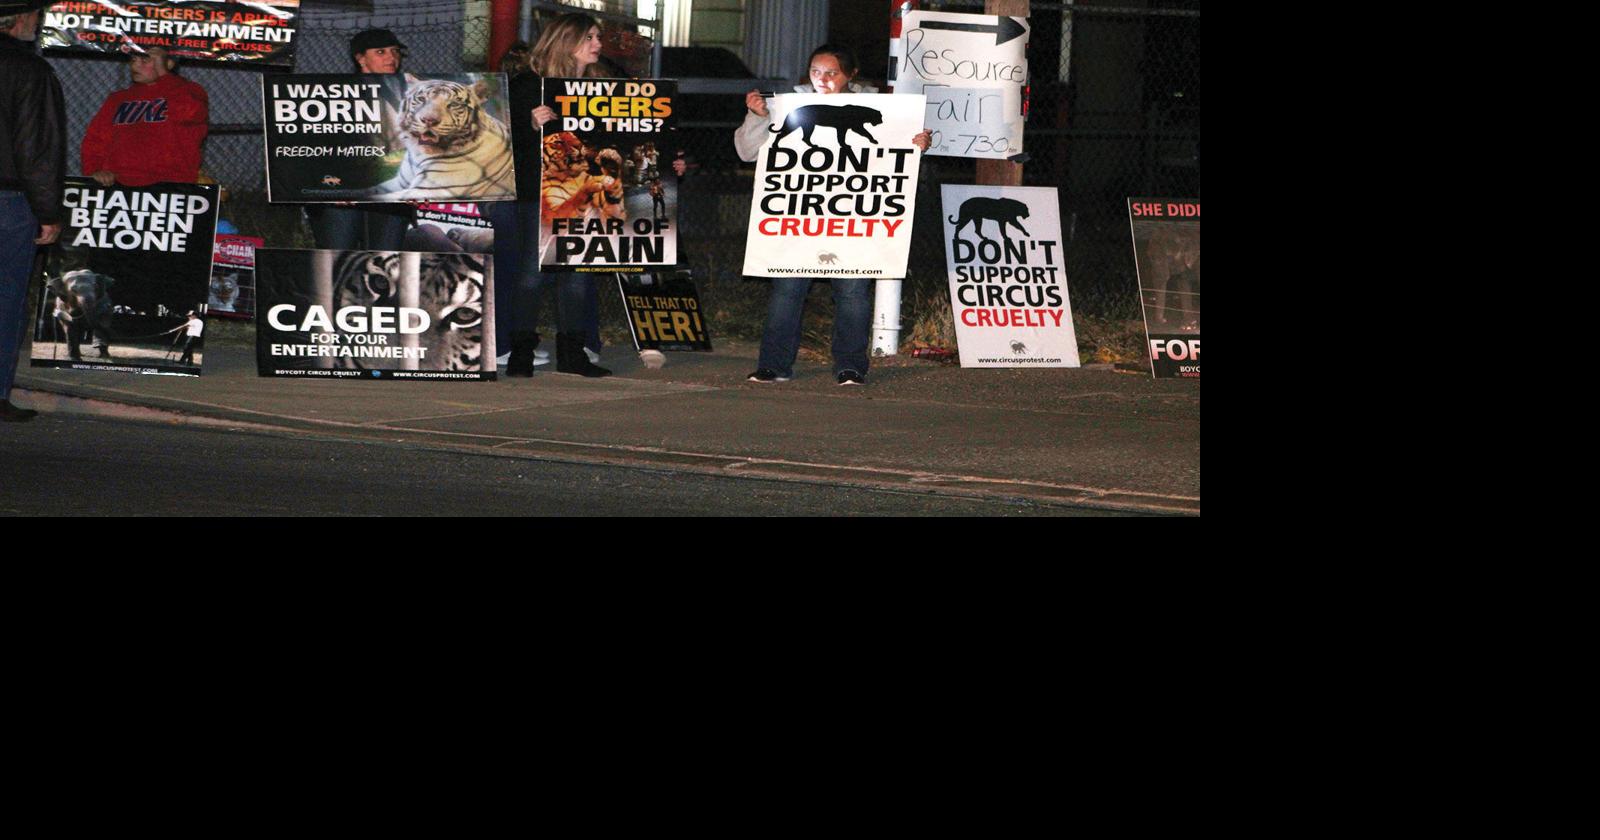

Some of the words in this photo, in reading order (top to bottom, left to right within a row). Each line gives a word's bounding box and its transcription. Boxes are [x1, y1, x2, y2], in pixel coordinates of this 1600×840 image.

[44, 12, 94, 30] NOT
[101, 16, 296, 42] ENTERTAINMENT
[145, 6, 205, 21] TIGERS
[210, 10, 226, 23] IS
[231, 12, 288, 27] ABUSE
[76, 32, 96, 41] GO
[100, 33, 116, 43] TO
[212, 40, 273, 53] CIRCUSES
[903, 29, 1025, 83] Resource
[273, 84, 280, 98] I
[286, 84, 381, 99] WASN'T
[565, 81, 617, 96] WHY
[624, 82, 657, 97] DO
[112, 98, 169, 126] NIKE
[274, 99, 381, 123] BORN
[555, 95, 672, 118] TIGERS
[275, 123, 298, 134] TO
[303, 123, 382, 134] PERFORM
[563, 117, 595, 132] DO
[602, 117, 664, 133] THIS?
[275, 146, 333, 157] FREEDOM
[337, 146, 386, 157] MATTERS
[765, 147, 914, 173] DON'T
[764, 174, 909, 193] SUPPORT
[62, 187, 210, 215] CHAINED
[760, 193, 906, 217] CIRCUS
[1132, 203, 1163, 217] SHE
[70, 207, 195, 234] BEATEN
[552, 218, 625, 235] FEAR
[633, 218, 669, 235] OF
[758, 217, 904, 238] CRUELTY
[72, 228, 187, 253] ALONE
[555, 236, 664, 263] PAIN
[952, 239, 1056, 265] DON'T
[767, 267, 883, 275] www.circusprotest.com
[955, 265, 1058, 284] SUPPORT
[627, 296, 653, 309] TELL
[653, 296, 679, 310] THAT
[681, 298, 697, 310] TO
[957, 285, 1063, 307] CIRCUS
[267, 303, 431, 334] CAGED
[632, 310, 705, 342] HER!
[961, 308, 1064, 327] CRUELTY
[311, 333, 340, 344] FOR
[344, 333, 388, 345] YOUR
[271, 344, 428, 359] ENTERTAINMENT
